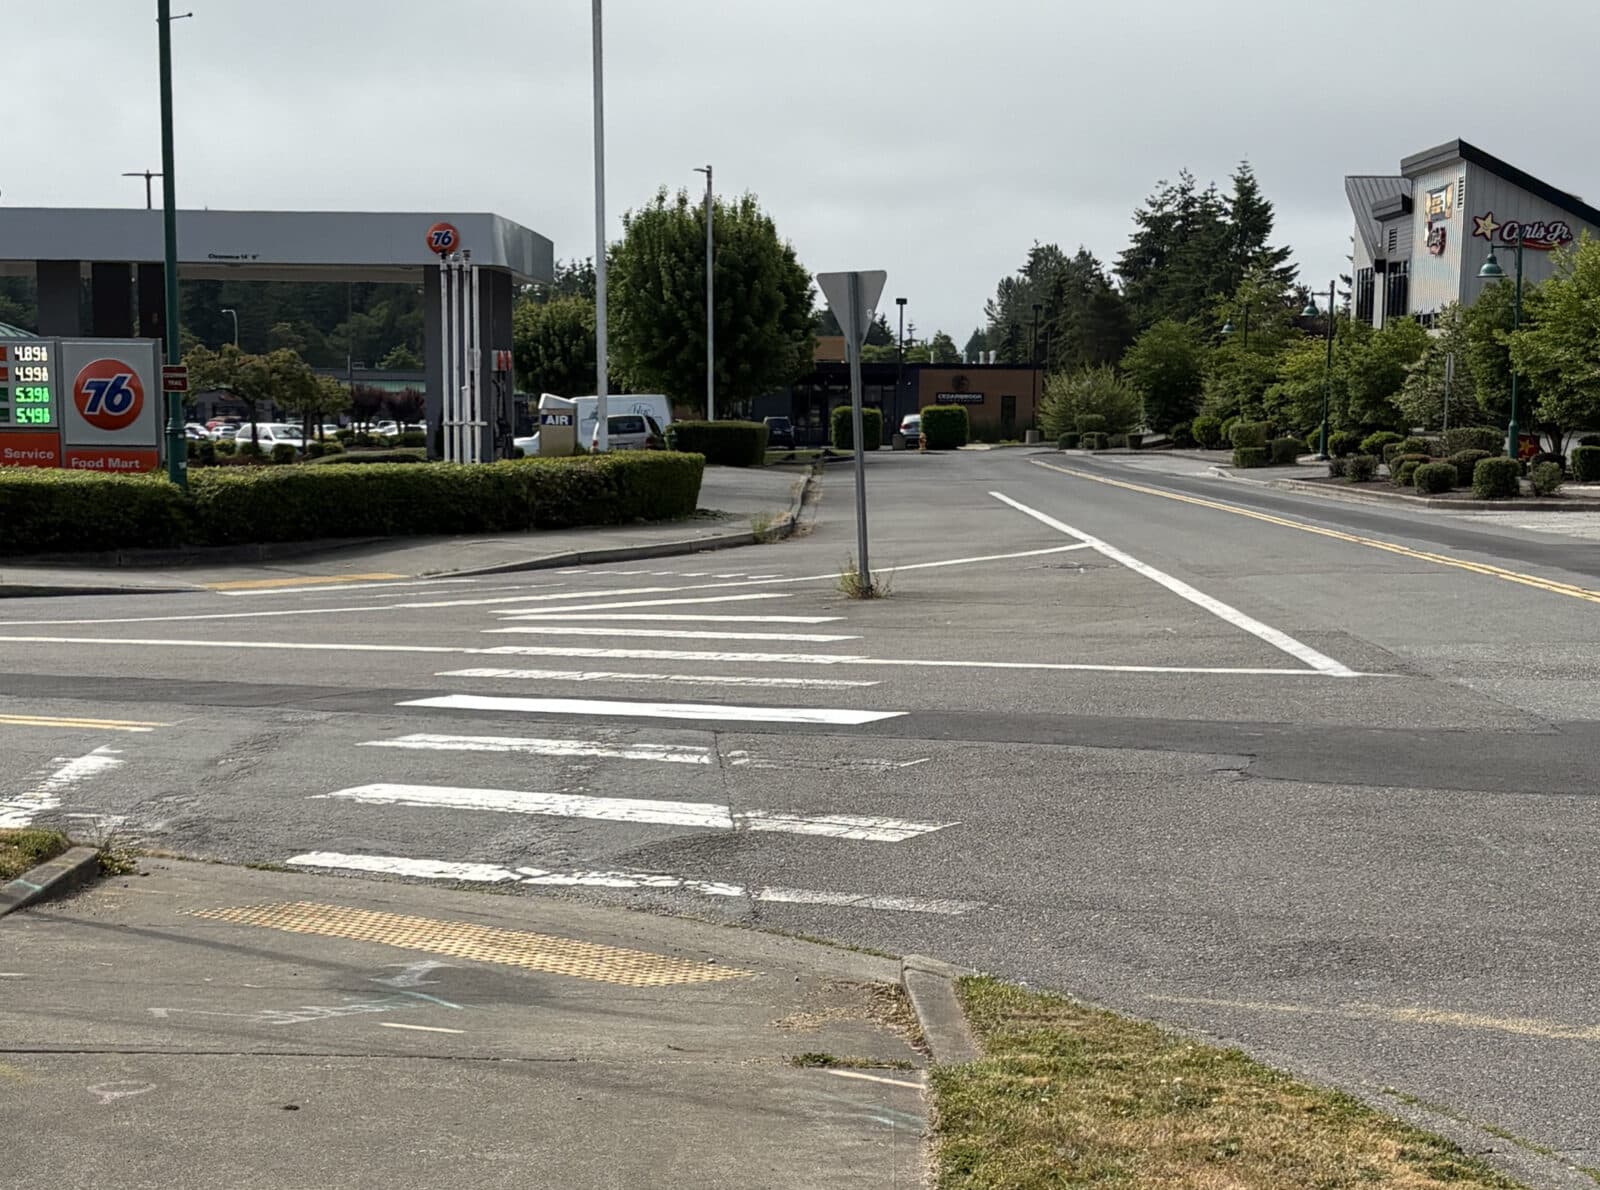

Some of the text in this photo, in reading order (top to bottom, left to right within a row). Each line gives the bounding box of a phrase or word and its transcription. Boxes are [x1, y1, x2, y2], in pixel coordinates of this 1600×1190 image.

[1546, 221, 1572, 241] Jr.
[432, 230, 452, 246] 76
[82, 374, 134, 415] 76
[545, 415, 569, 425] AIR
[4, 448, 54, 459] Service
[71, 457, 140, 468] Food Mart
